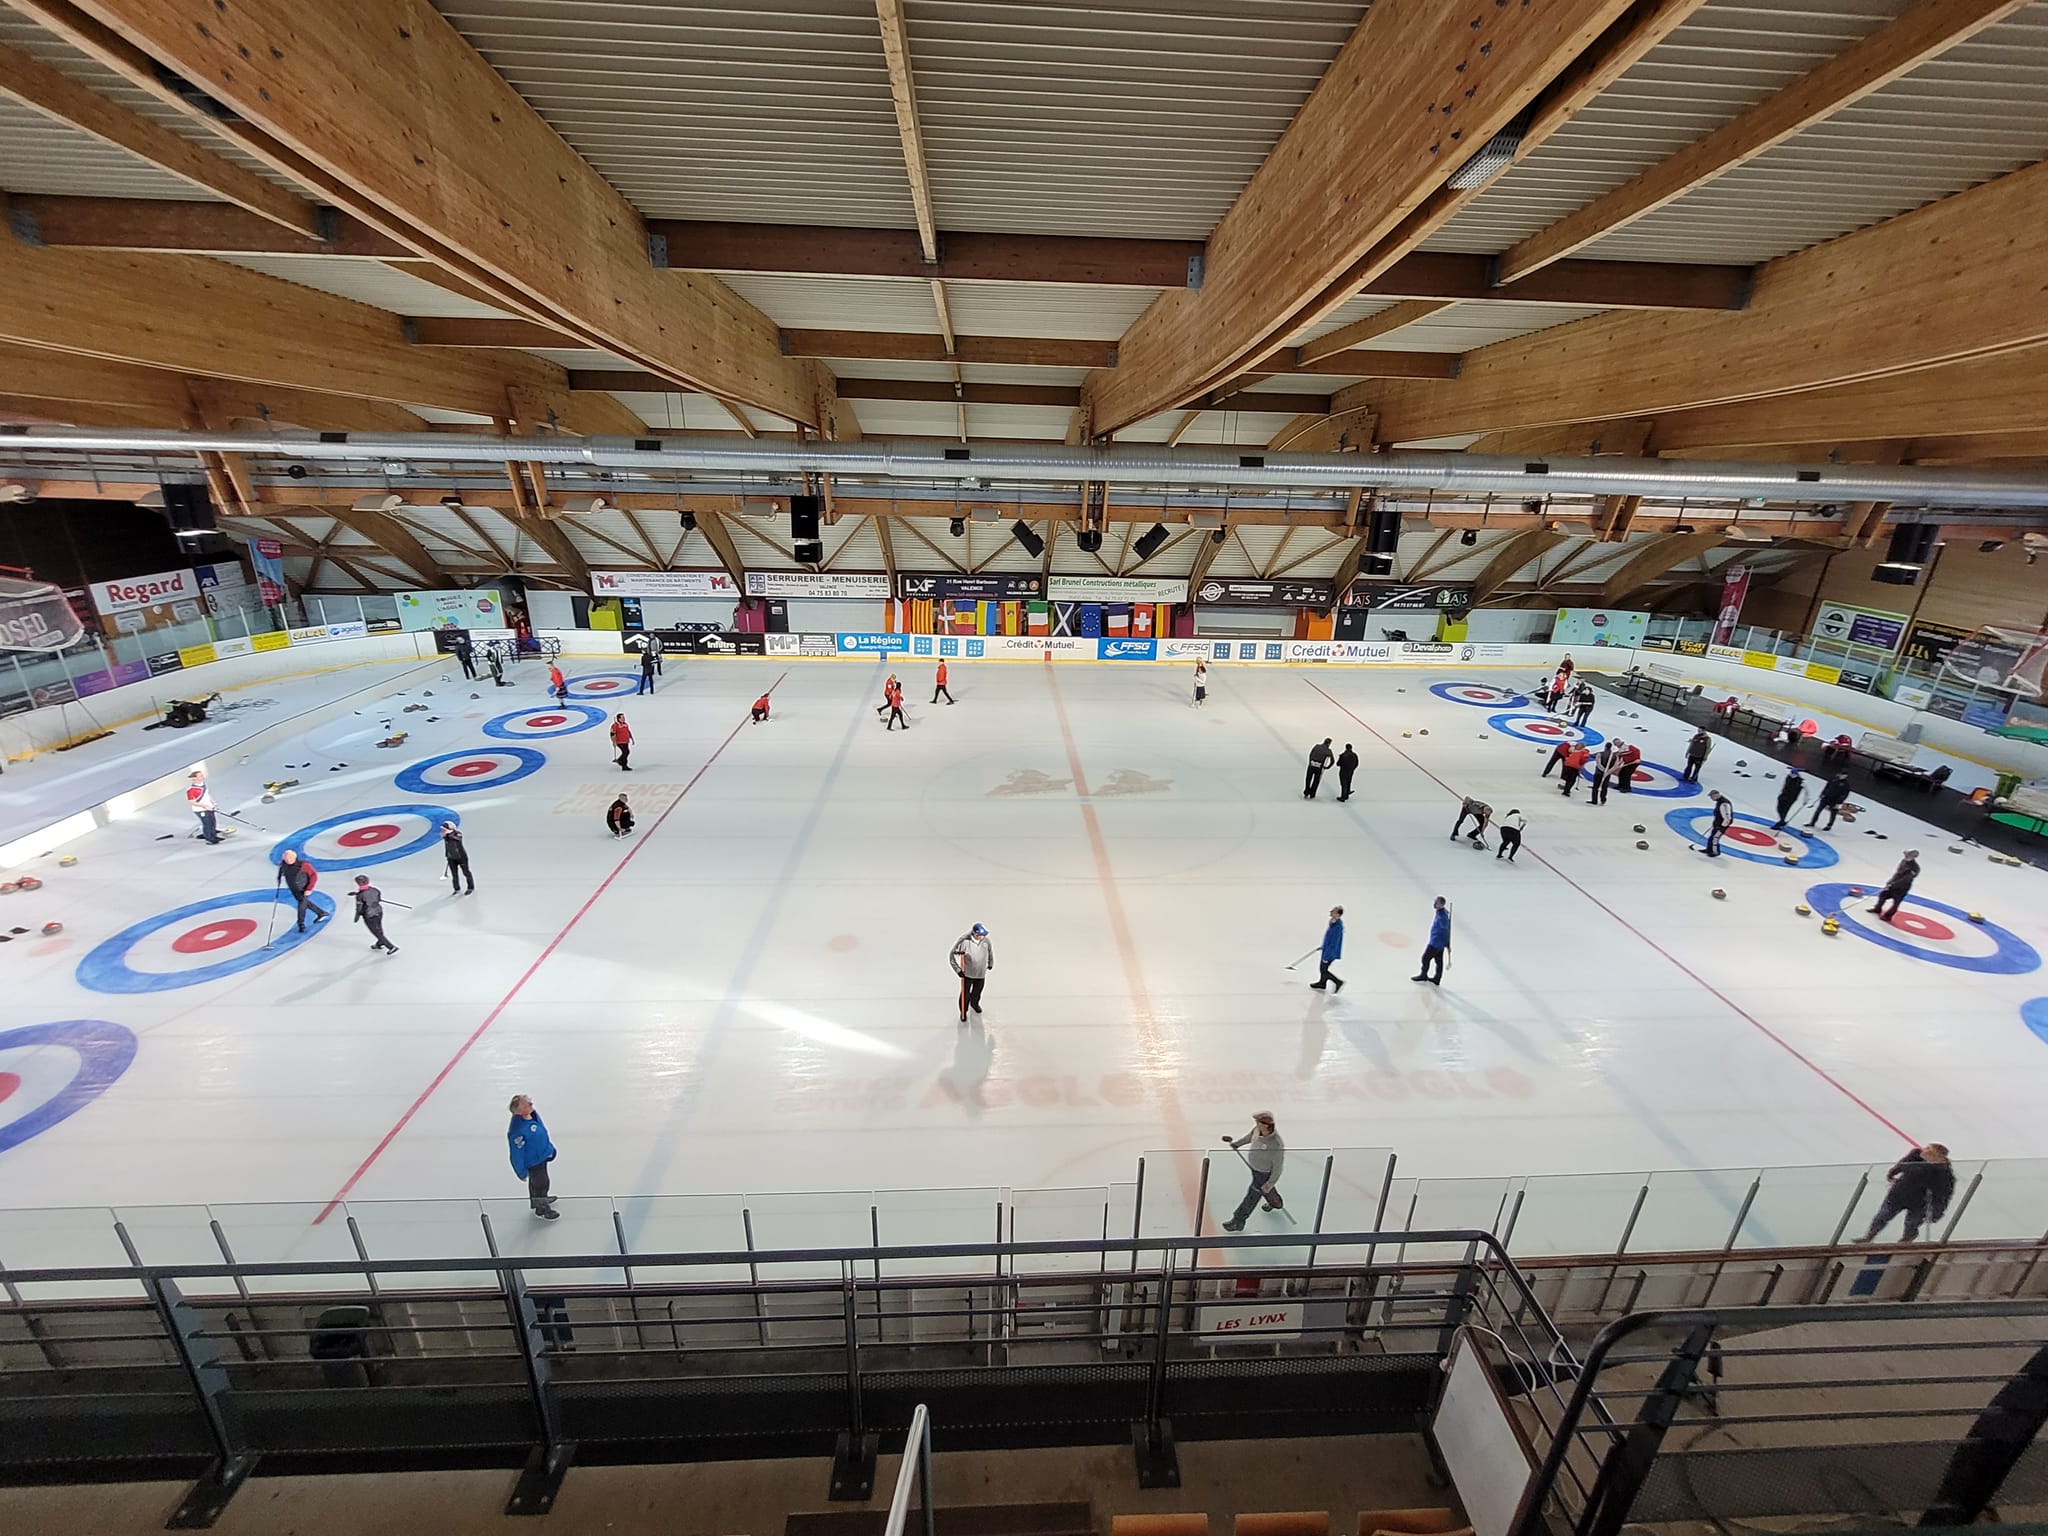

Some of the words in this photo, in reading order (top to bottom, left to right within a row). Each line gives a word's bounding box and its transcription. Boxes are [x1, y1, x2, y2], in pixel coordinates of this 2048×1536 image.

[766, 574, 825, 583] SERRURERIE
[832, 576, 888, 584] MENUISERIE
[1062, 578, 1082, 586] Brunel
[1082, 579, 1122, 588] Constructions
[1123, 580, 1157, 589] métalliques
[106, 573, 184, 603] Regard
[906, 578, 937, 593] LXF
[1157, 584, 1181, 597] RECRUTE
[1450, 593, 1468, 606] AJS
[858, 636, 869, 644] La
[870, 635, 903, 646] Région
[1006, 640, 1034, 649] Crédit
[1044, 640, 1075, 649] Mutuel
[1120, 641, 1151, 650] FFSG
[1180, 643, 1210, 651] FFSG
[1292, 644, 1331, 657] Crédit
[1346, 644, 1390, 658] Mutuel
[1215, 1318, 1242, 1331] LES
[1249, 1312, 1287, 1326] LYNX
